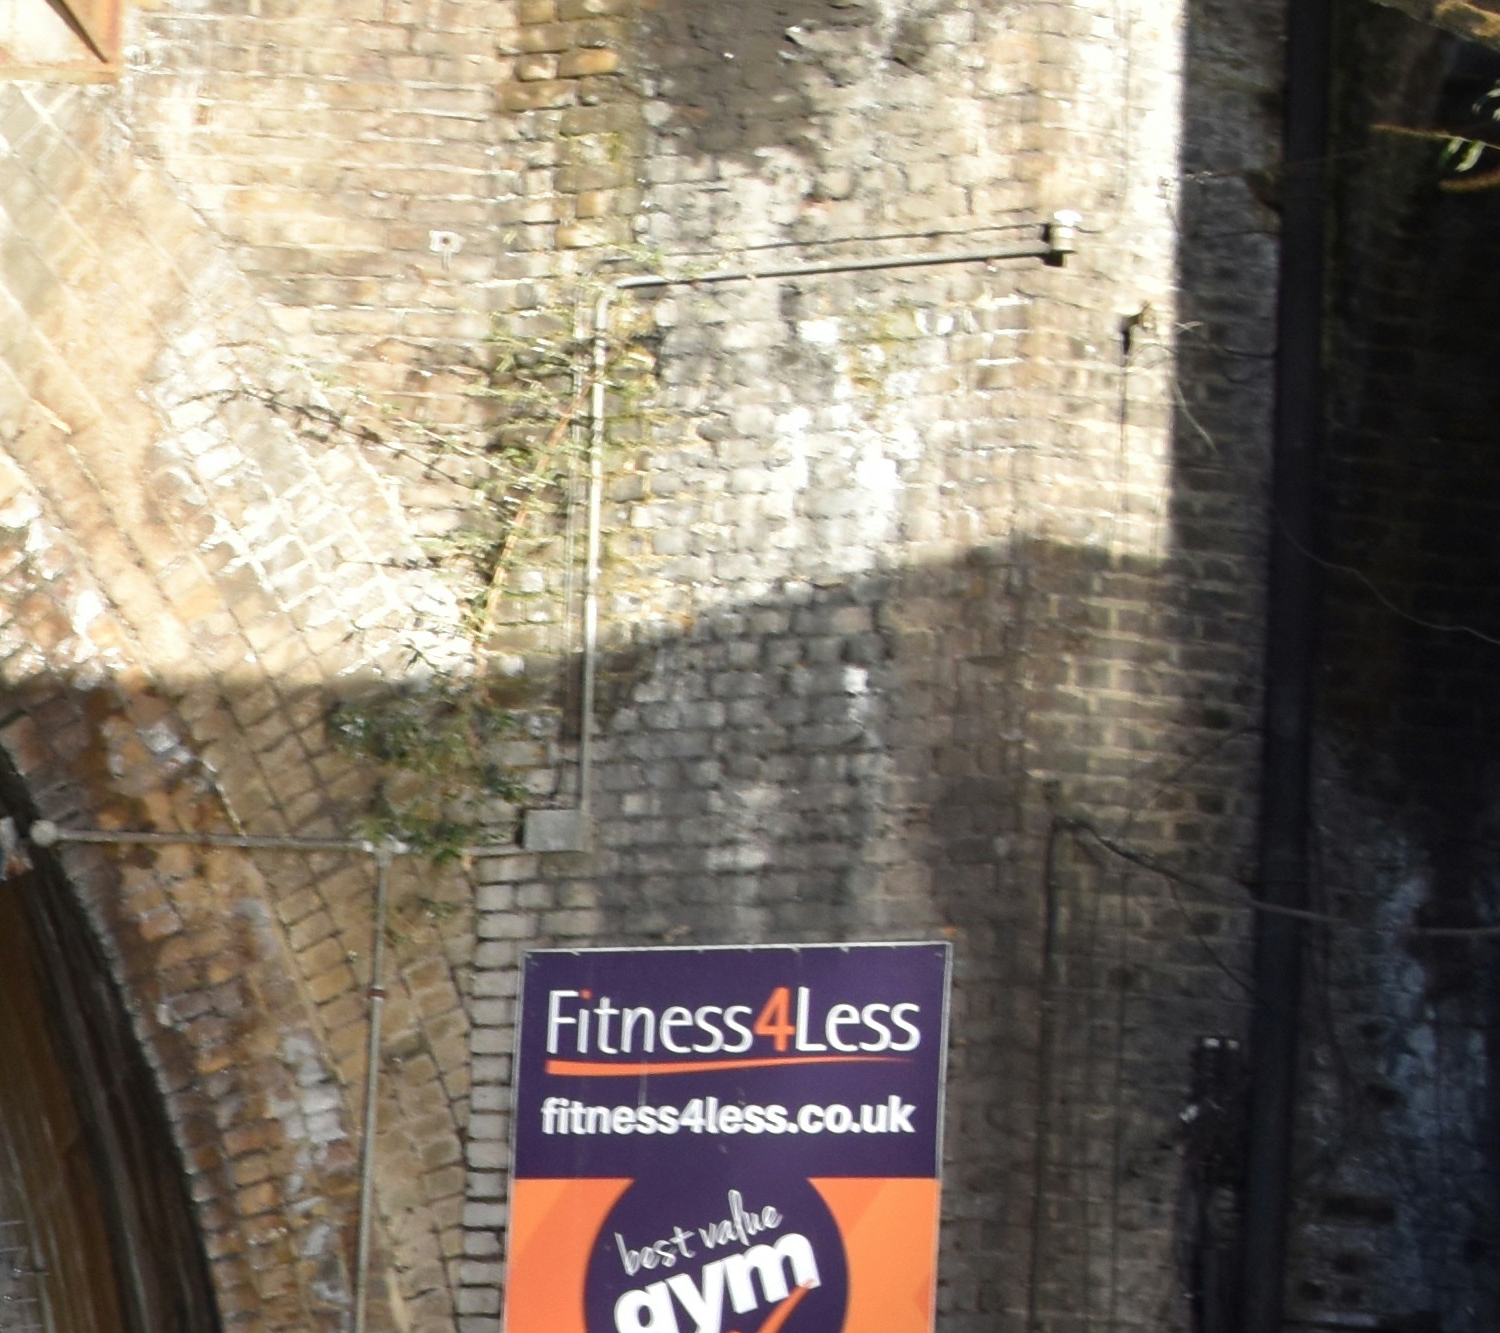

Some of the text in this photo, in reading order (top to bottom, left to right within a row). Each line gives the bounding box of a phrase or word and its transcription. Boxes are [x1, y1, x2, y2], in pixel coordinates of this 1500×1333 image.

[546, 985, 921, 1056] Fitness4Less
[541, 1095, 917, 1135] fitness4less.co.uk
[614, 1189, 784, 1277] best value
